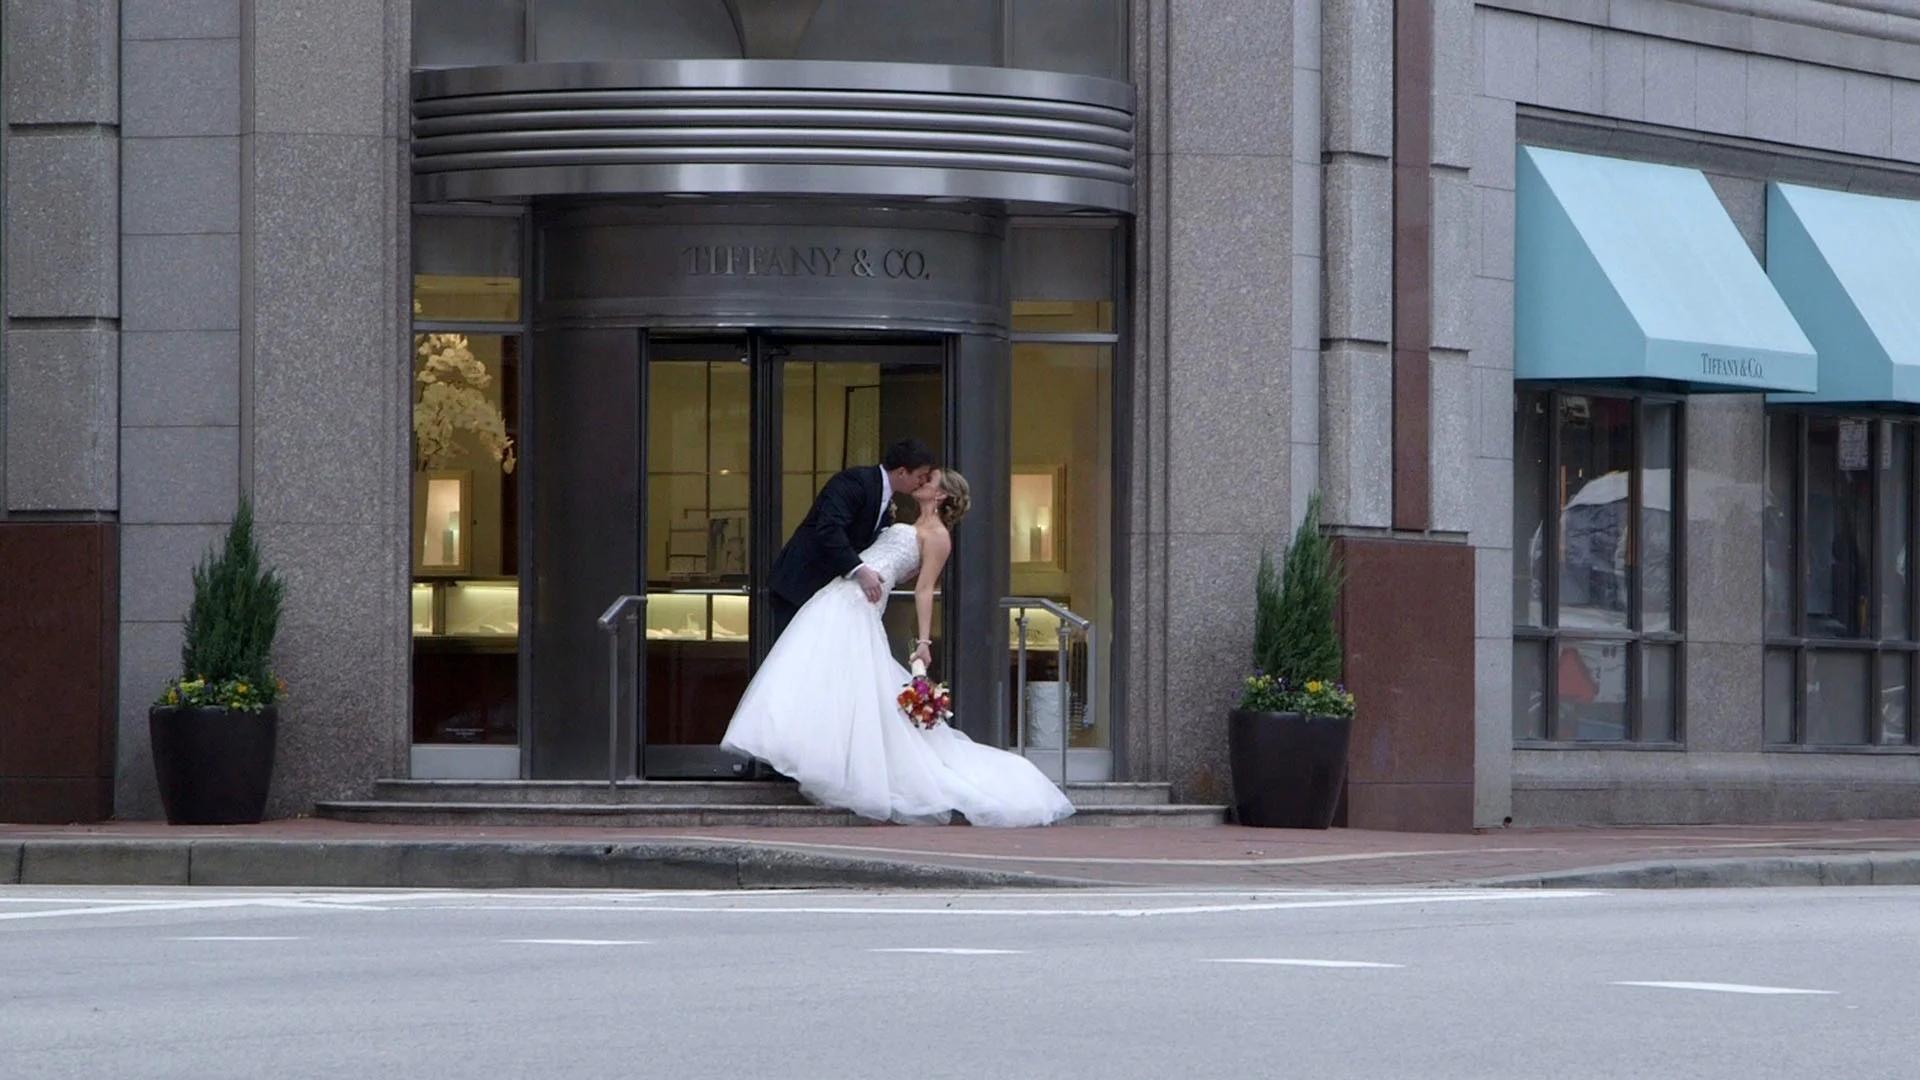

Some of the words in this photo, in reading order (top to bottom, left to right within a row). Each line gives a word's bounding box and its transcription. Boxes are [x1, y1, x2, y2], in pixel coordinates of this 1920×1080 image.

[682, 246, 840, 277] TIFFANY
[852, 249, 876, 278] &
[883, 248, 931, 280] CO.
